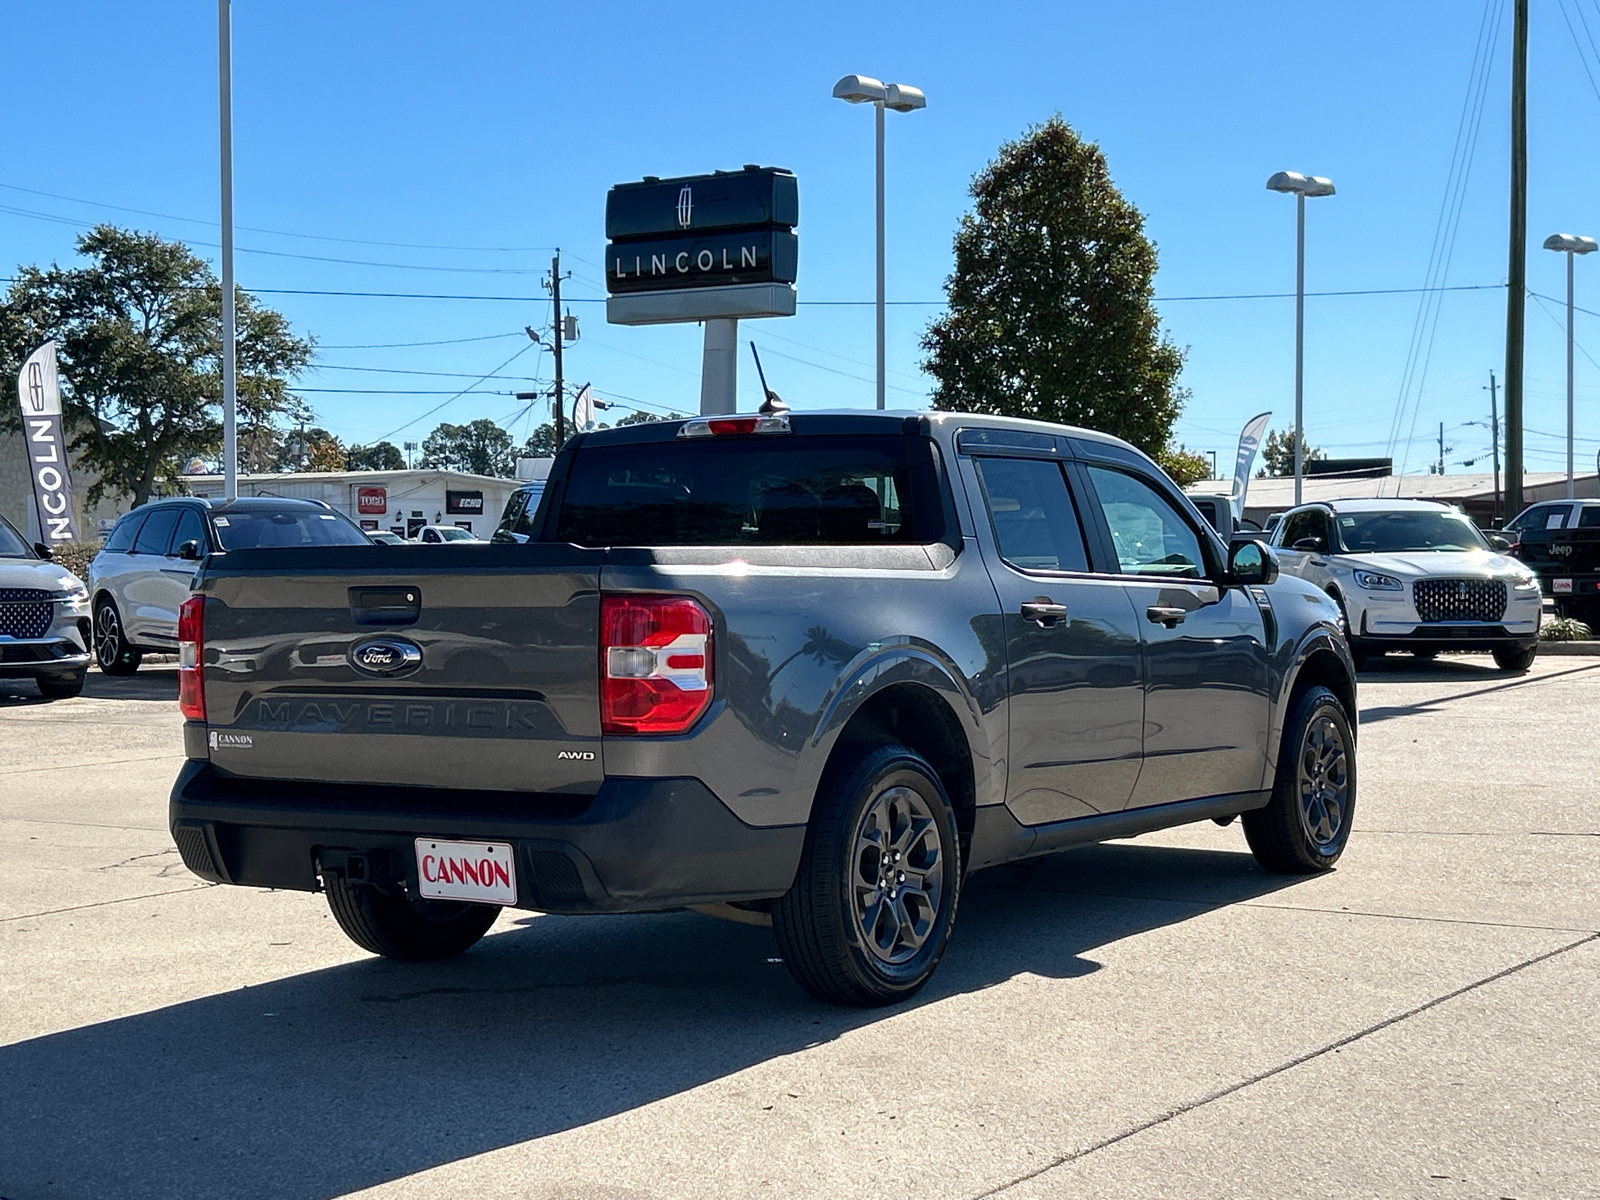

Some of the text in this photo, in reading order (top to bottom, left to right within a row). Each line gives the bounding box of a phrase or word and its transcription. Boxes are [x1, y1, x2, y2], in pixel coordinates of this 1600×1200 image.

[615, 245, 757, 278] LINCOLN
[30, 420, 73, 540] NCOLN
[360, 495, 385, 507] TORO
[458, 498, 483, 508] ECHO
[1548, 543, 1573, 557] Jeep
[363, 646, 393, 664] Ford
[257, 700, 537, 731] MAVERICK
[218, 734, 253, 744] CANNON
[557, 751, 595, 760] AWD
[422, 854, 510, 889] CANNON
